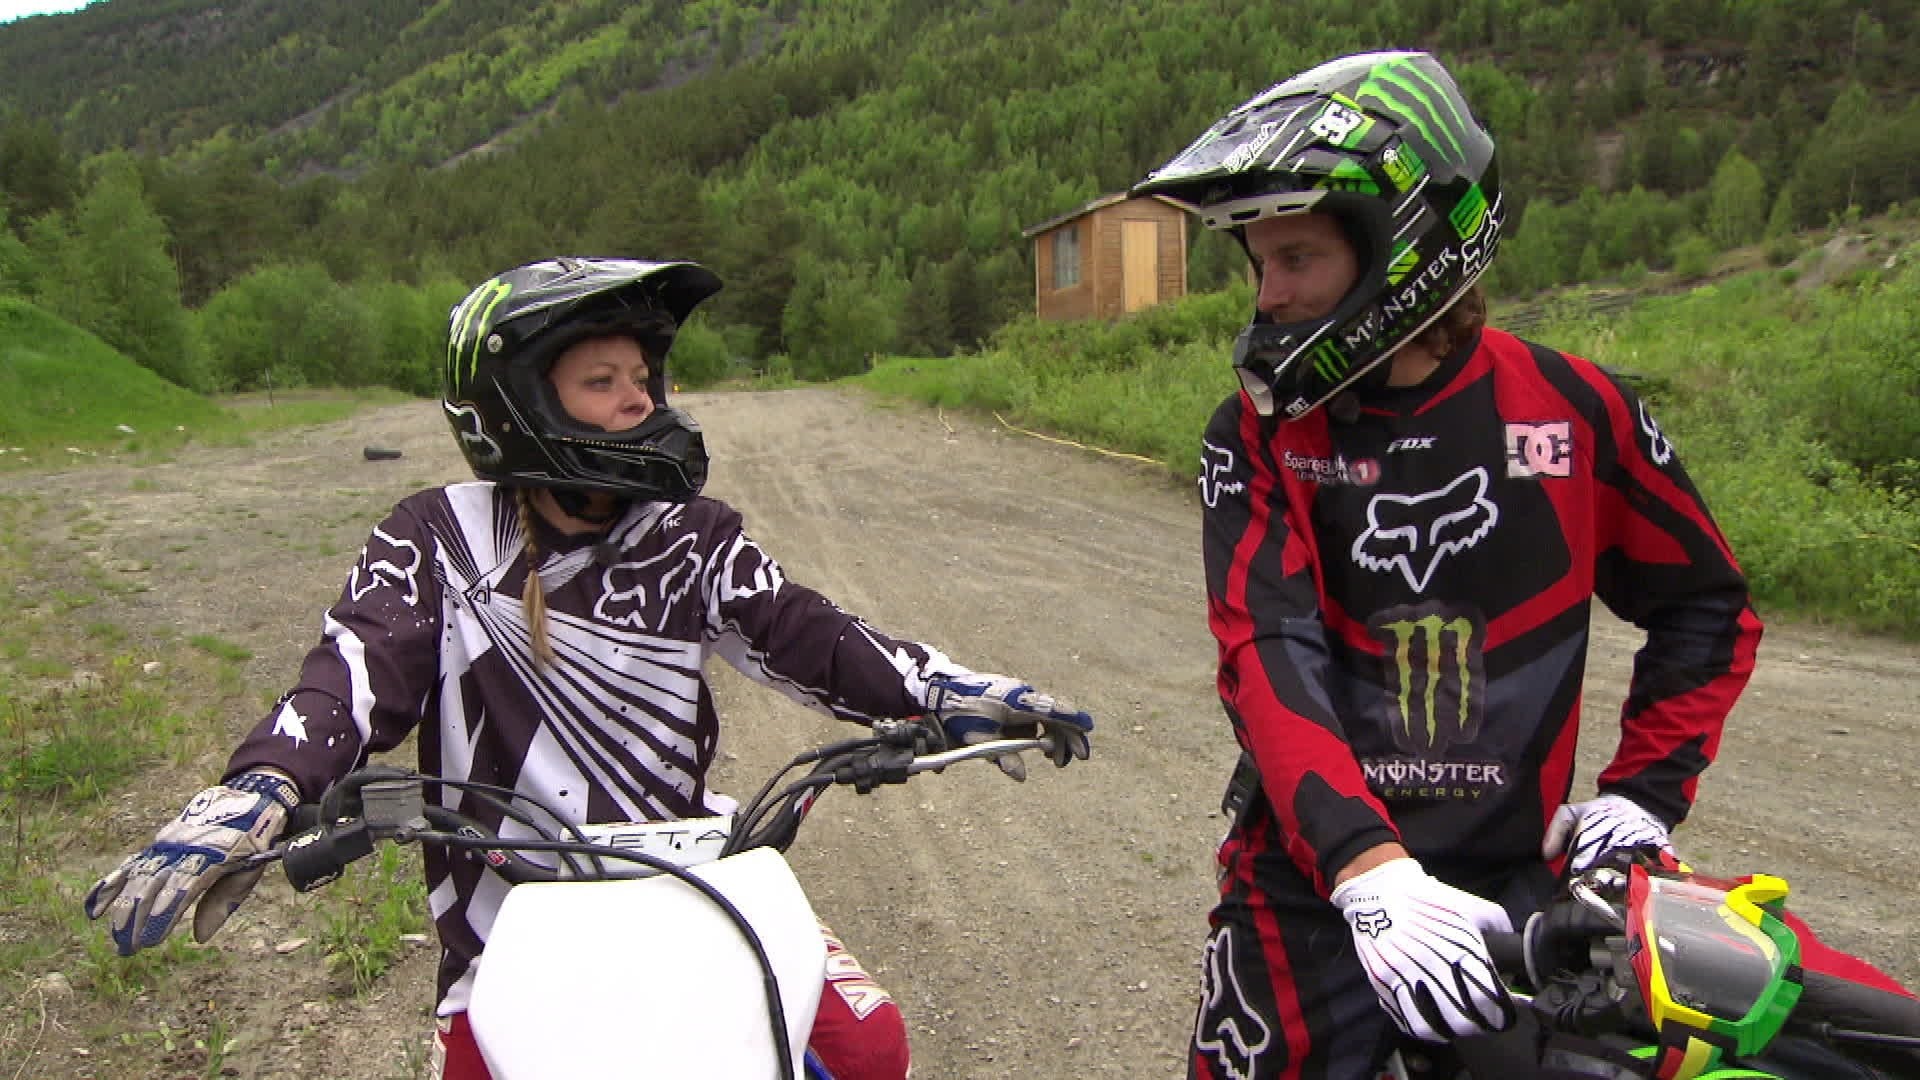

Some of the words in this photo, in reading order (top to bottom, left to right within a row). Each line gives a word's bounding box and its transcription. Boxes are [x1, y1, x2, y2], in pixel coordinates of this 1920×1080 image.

[1386, 437, 1438, 454] FOX
[1505, 421, 1570, 477] DC
[1284, 450, 1349, 476] SpareBk
[1362, 759, 1505, 785] MONSTER
[1384, 787, 1482, 799] ENERGY
